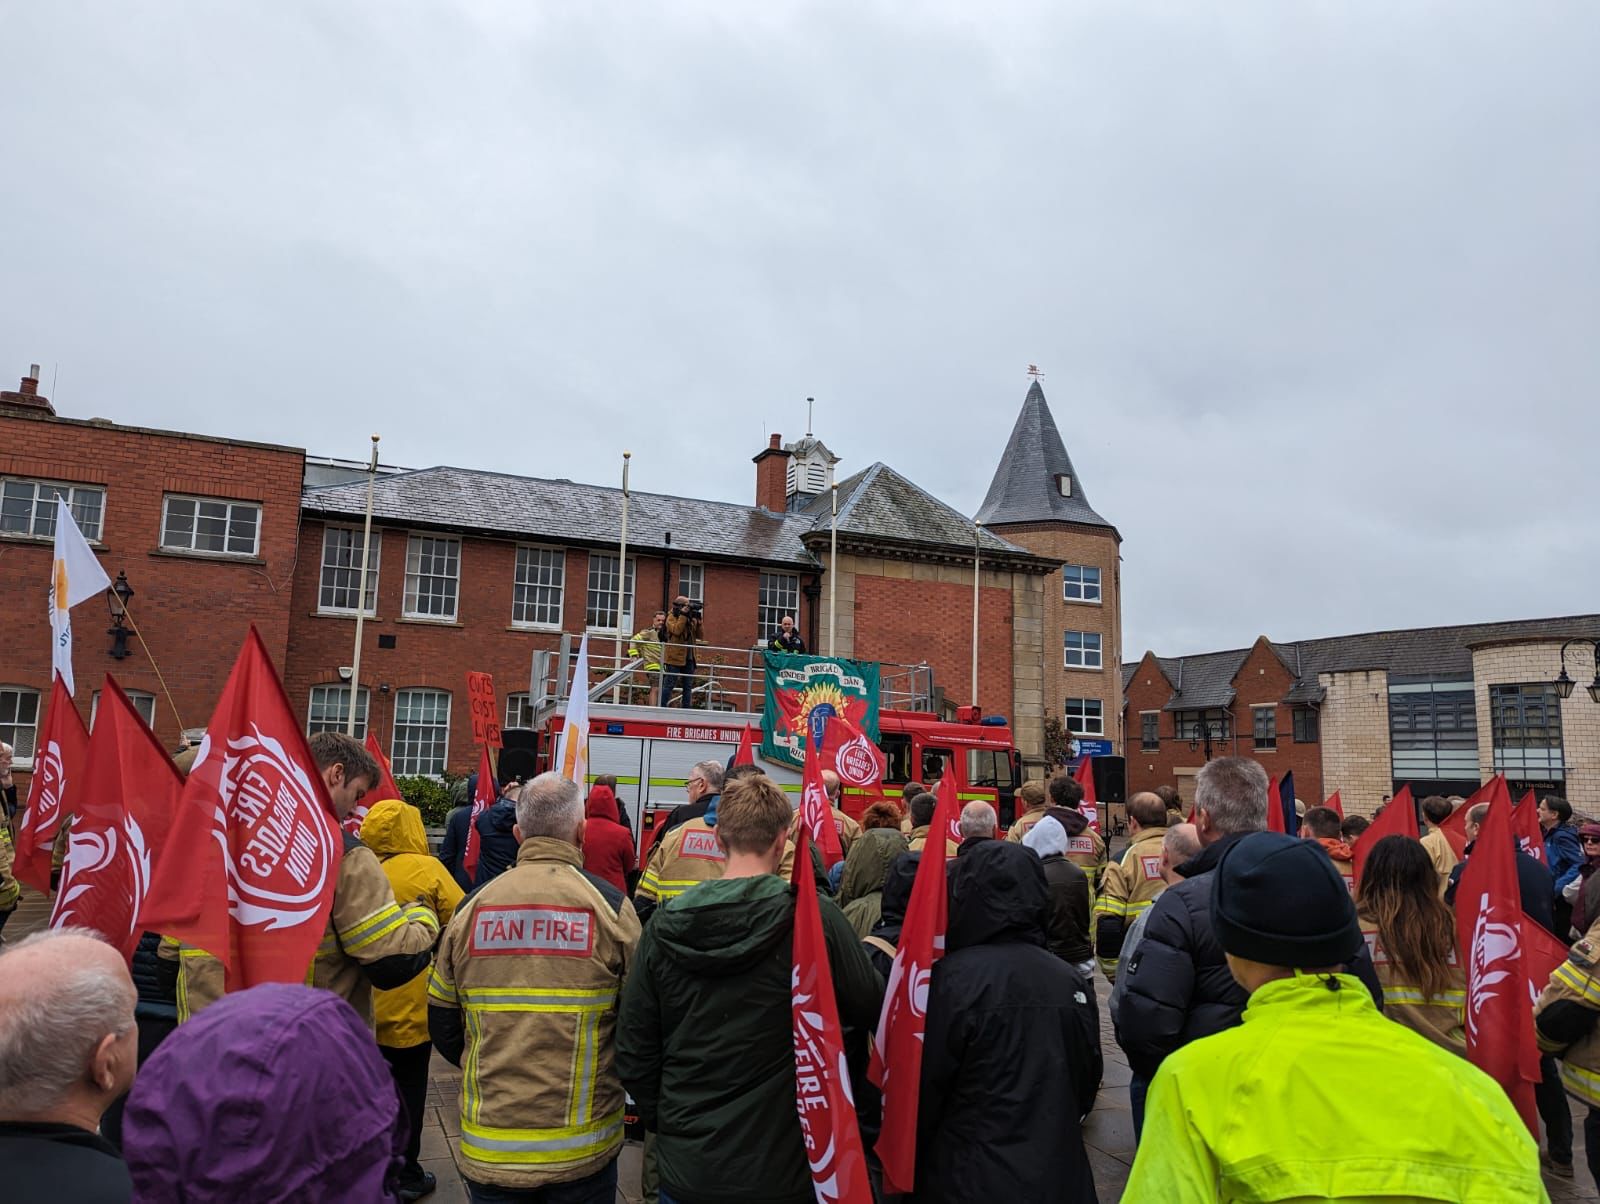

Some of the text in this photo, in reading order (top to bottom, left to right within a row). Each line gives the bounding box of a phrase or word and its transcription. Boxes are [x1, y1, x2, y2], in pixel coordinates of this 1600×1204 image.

[469, 676, 493, 695] CUTS
[472, 698, 496, 719] COST
[475, 720, 500, 742] LIVES
[666, 726, 741, 741] FIRE BRIGADES UNION
[846, 754, 871, 771] BRIGADES
[1070, 839, 1092, 850] FIRE
[531, 919, 585, 943] FIRE
[794, 1046, 829, 1110] FIRE
